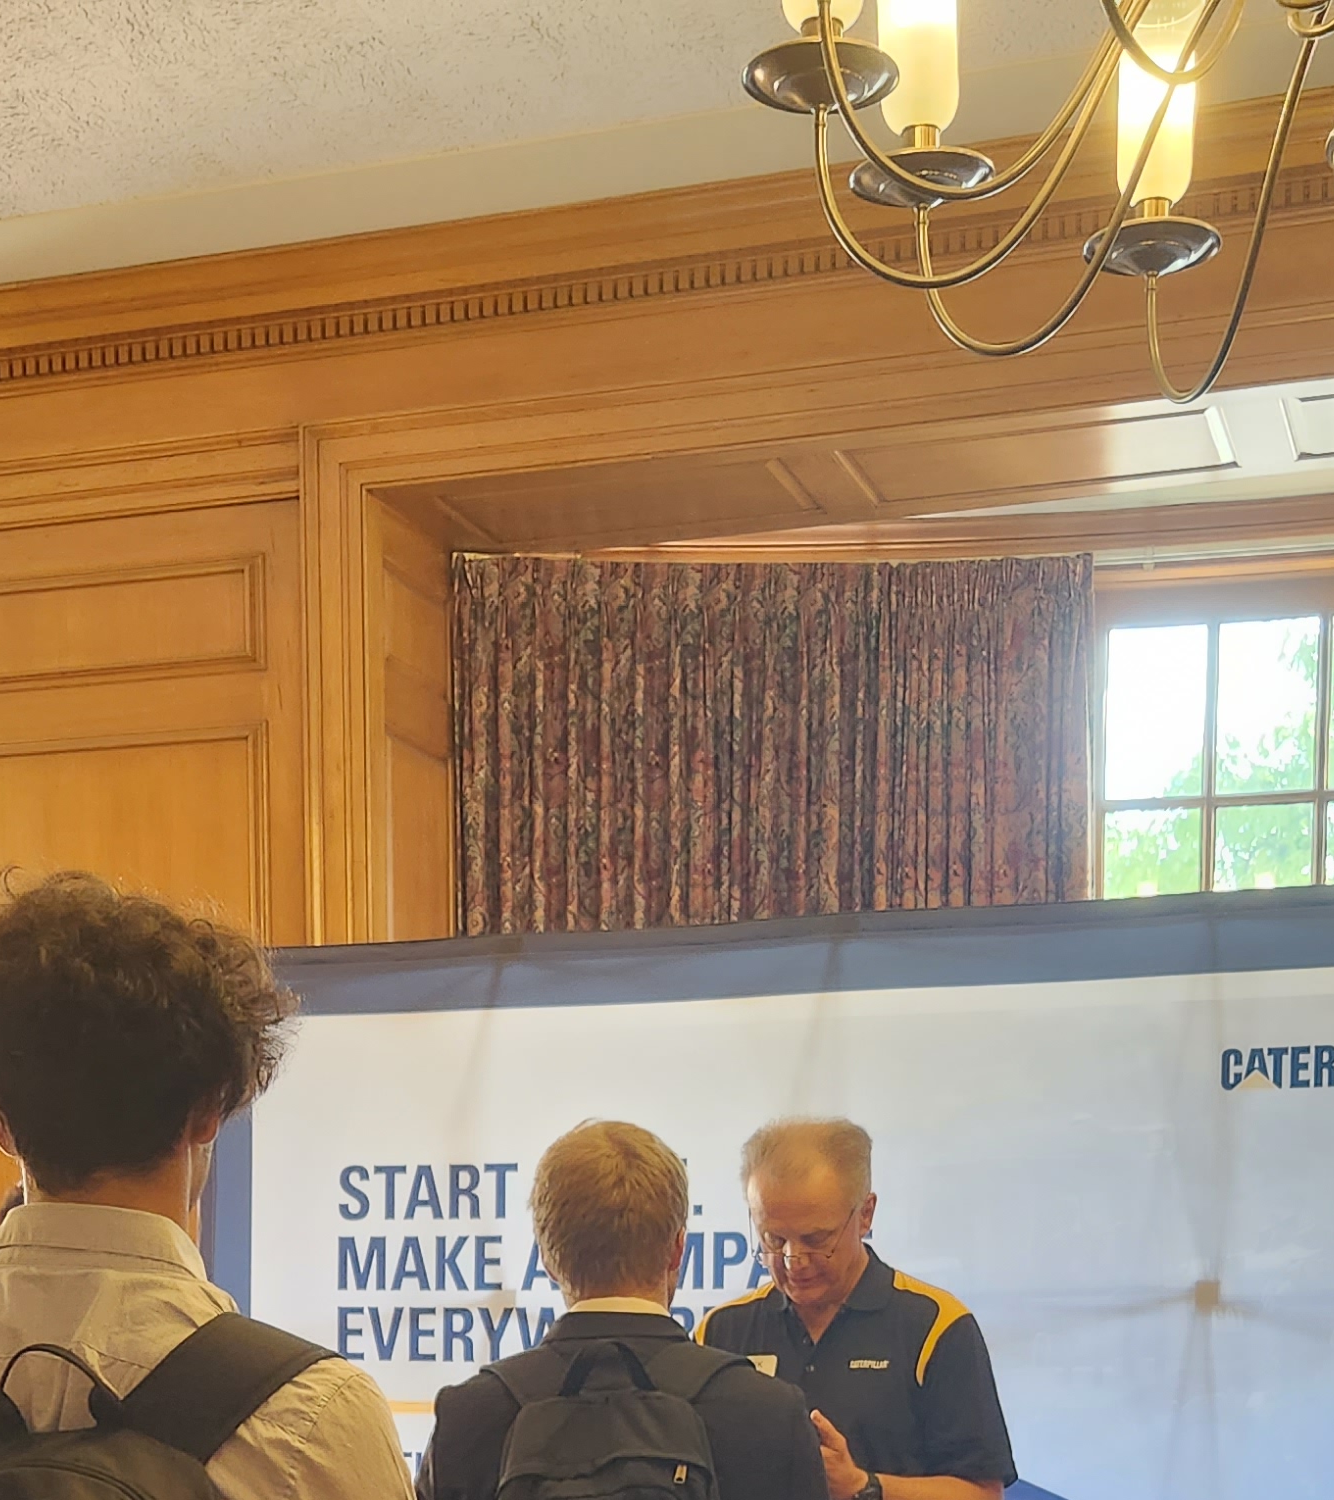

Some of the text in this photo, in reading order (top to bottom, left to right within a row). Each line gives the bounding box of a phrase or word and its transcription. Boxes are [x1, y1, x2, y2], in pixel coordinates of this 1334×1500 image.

[338, 1162, 518, 1221] START
[337, 1235, 503, 1291] MAKE
[521, 1239, 561, 1291] A
